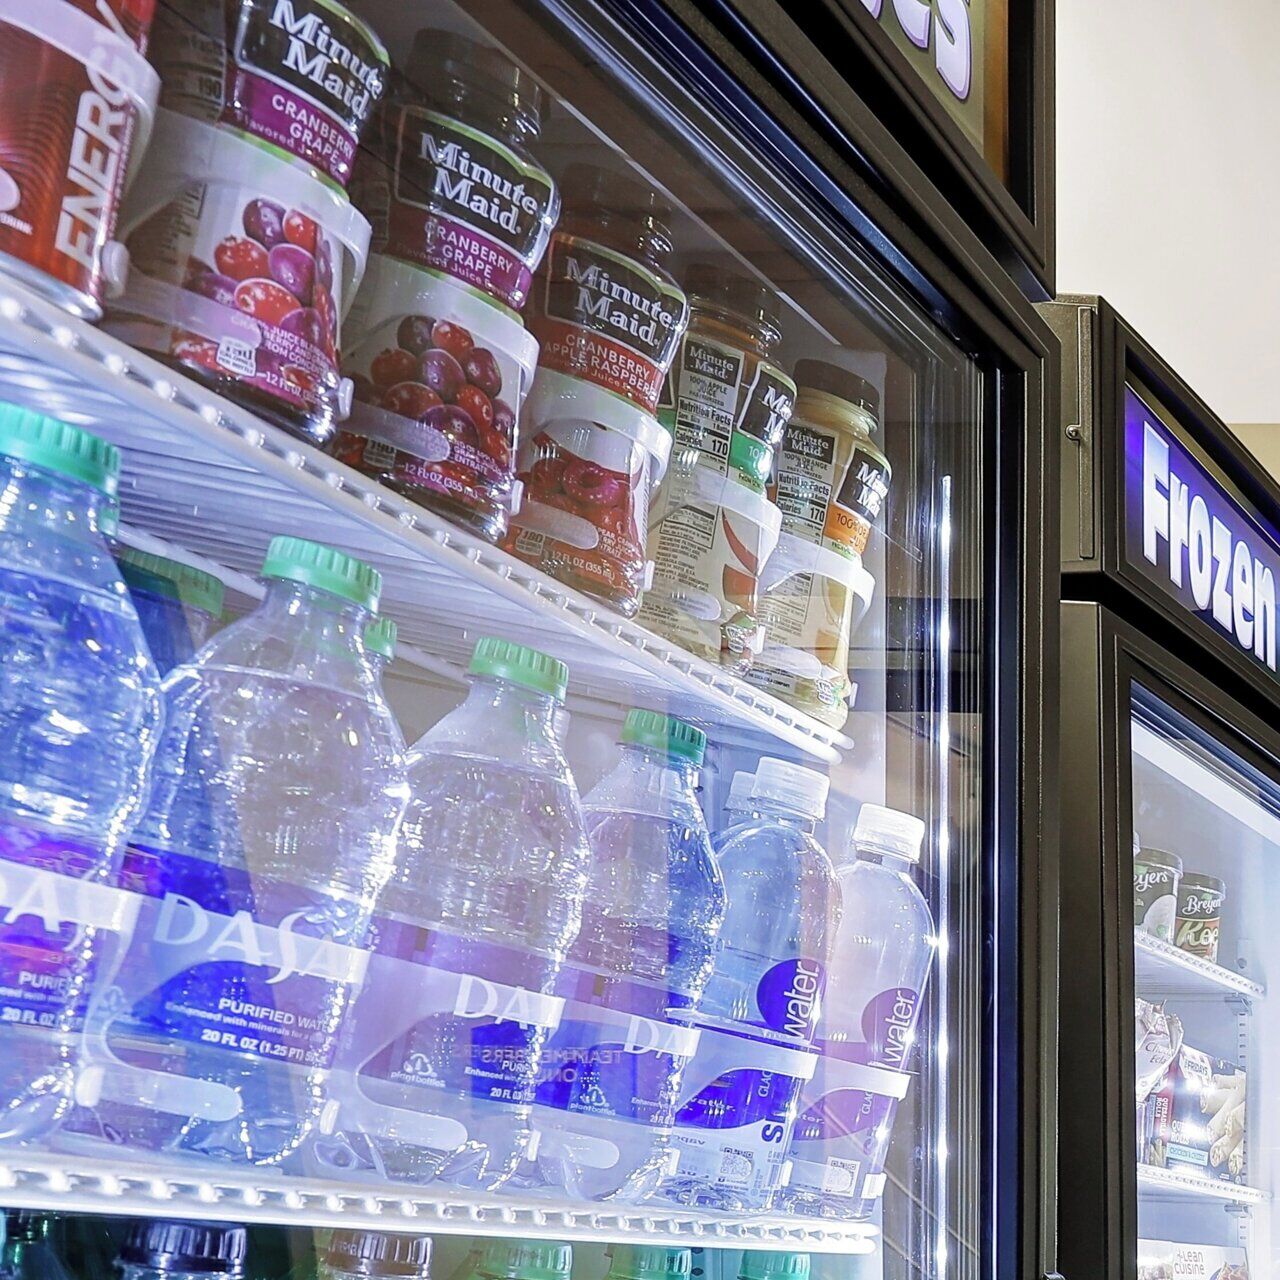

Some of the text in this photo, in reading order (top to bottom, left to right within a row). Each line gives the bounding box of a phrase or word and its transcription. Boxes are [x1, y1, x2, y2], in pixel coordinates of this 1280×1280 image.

[282, 35, 371, 120] Maid
[272, 94, 353, 160] CRANBERRY
[290, 123, 340, 164] GRAPE
[418, 131, 538, 215] Minute
[435, 167, 519, 235] Maid
[425, 220, 514, 273] CRANBERRY
[442, 244, 494, 279] GRAPE
[565, 256, 673, 329] Minute
[575, 286, 658, 347] Maid
[544, 341, 587, 364] APPLE
[566, 334, 651, 380] CRANBERRY
[690, 346, 734, 372] Minute
[694, 359, 727, 379] Maid
[711, 410, 731, 426] Facts
[711, 439, 728, 456] 170
[787, 428, 829, 450] Minute
[810, 506, 824, 523] 170
[1143, 420, 1276, 674] Frozen
[219, 998, 295, 1026] PURIFIED
[201, 1029, 219, 1042] 20
[240, 1037, 259, 1052] OZ
[1174, 1263, 1206, 1276] cuisine
[1184, 1250, 1205, 1262] Lean
